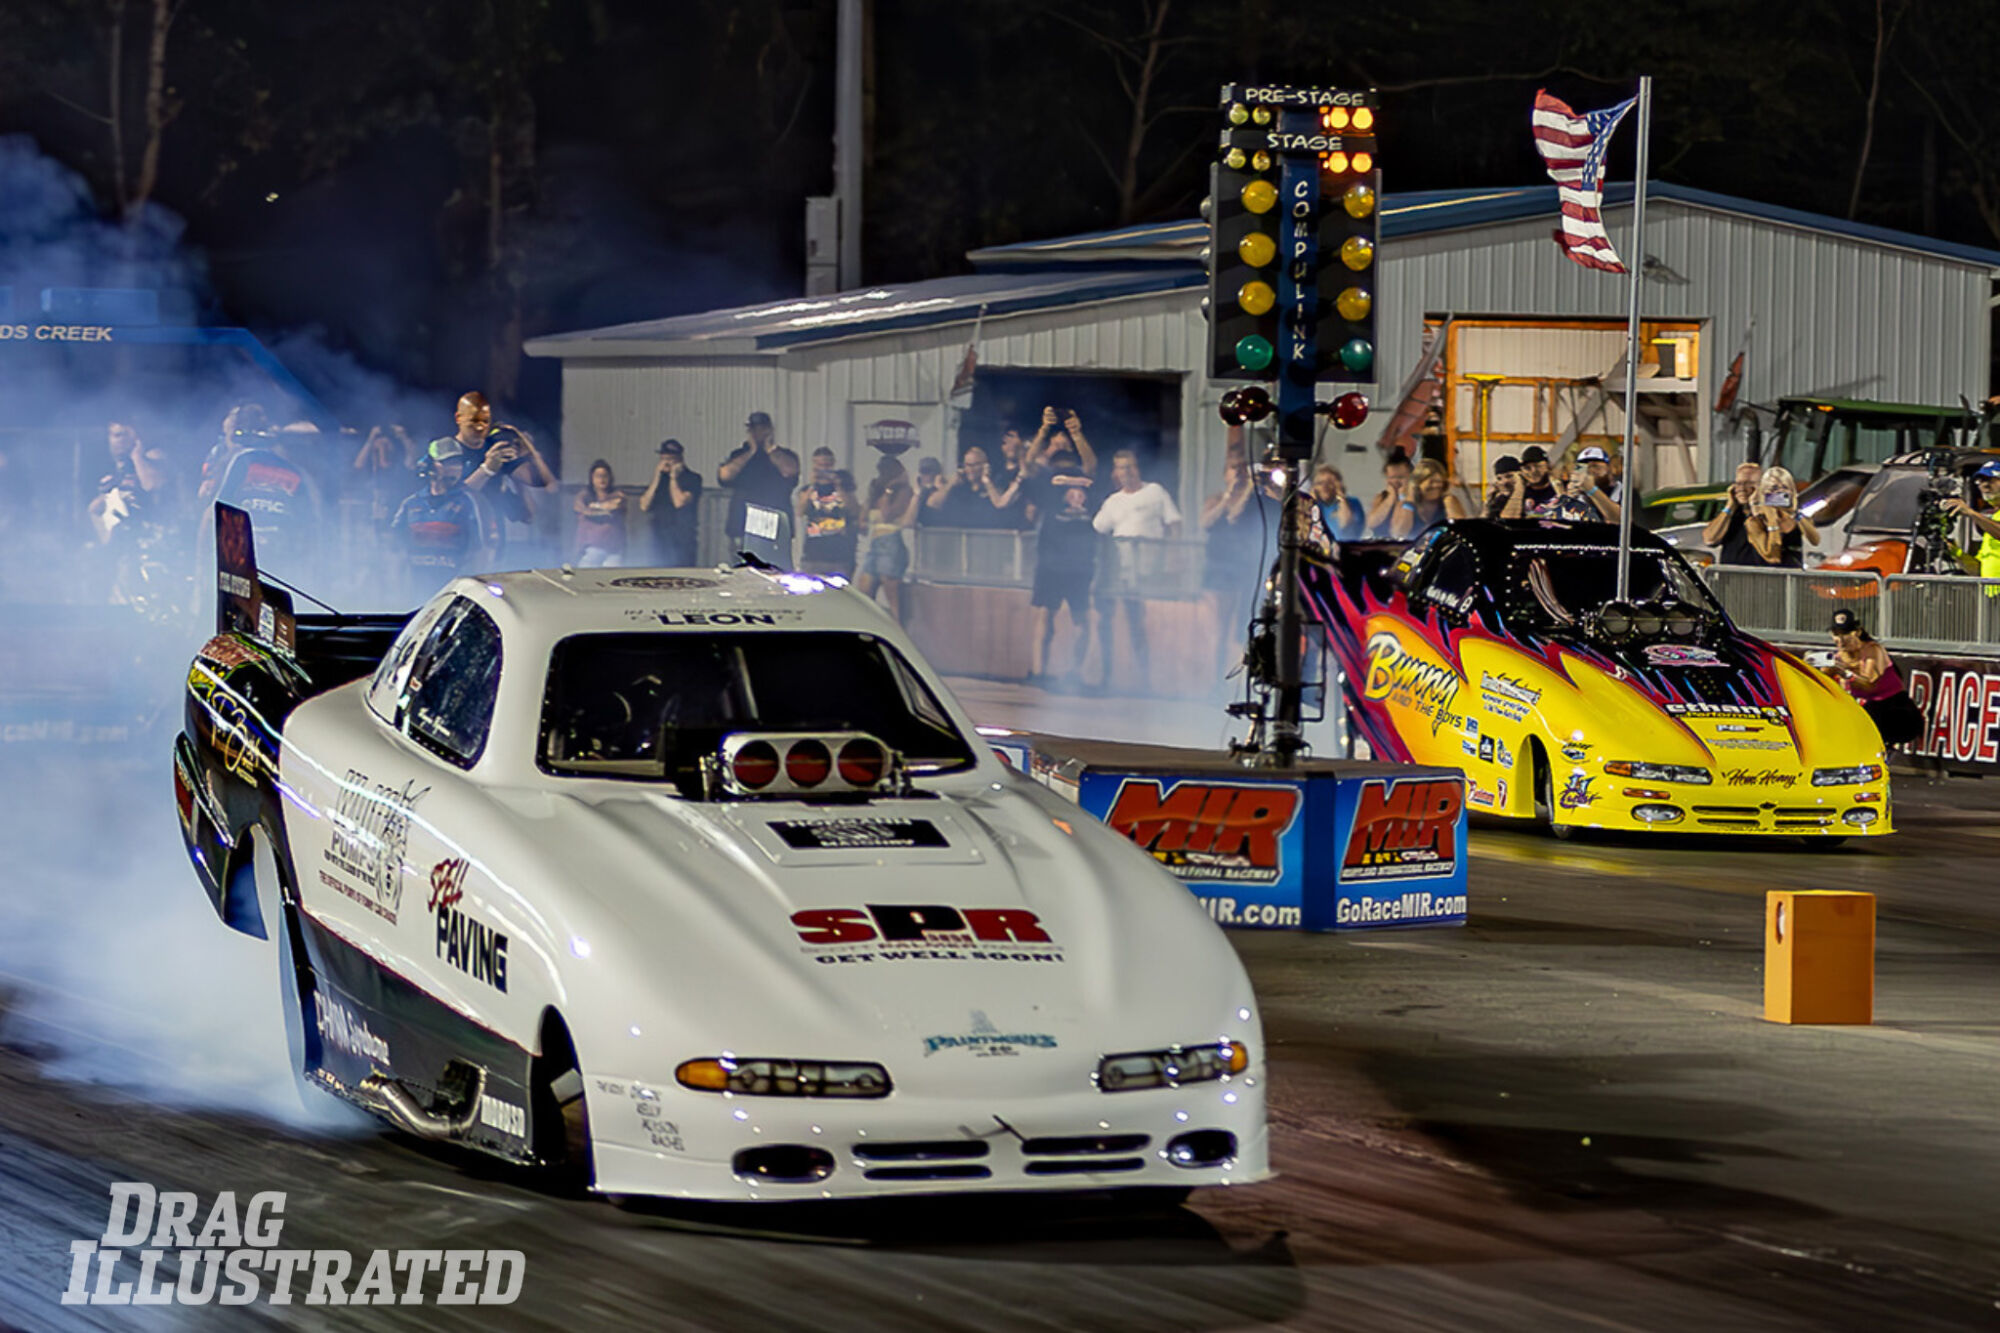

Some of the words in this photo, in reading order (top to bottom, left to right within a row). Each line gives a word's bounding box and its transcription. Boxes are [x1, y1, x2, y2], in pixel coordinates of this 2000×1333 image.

[1245, 88, 1365, 107] PRE-STAGE
[1267, 132, 1343, 151] STAGE
[1292, 180, 1311, 361] COMPULINK
[34, 324, 113, 342] CREEK
[657, 613, 776, 626] LEON
[1363, 631, 1460, 738] Bunny
[1415, 700, 1434, 717] THE
[1435, 708, 1463, 729] BOYS
[1908, 668, 2000, 763] RACE
[1105, 780, 1299, 868] MIR
[1344, 780, 1463, 866] MIR
[1223, 868, 1278, 880] RACEWAY
[789, 903, 1053, 945] SPR
[1336, 892, 1467, 924] GoRaceMIR.com
[437, 902, 508, 994] PAVING
[814, 953, 876, 964] GET
[878, 950, 967, 961] WELL
[970, 952, 1066, 963] SOON!
